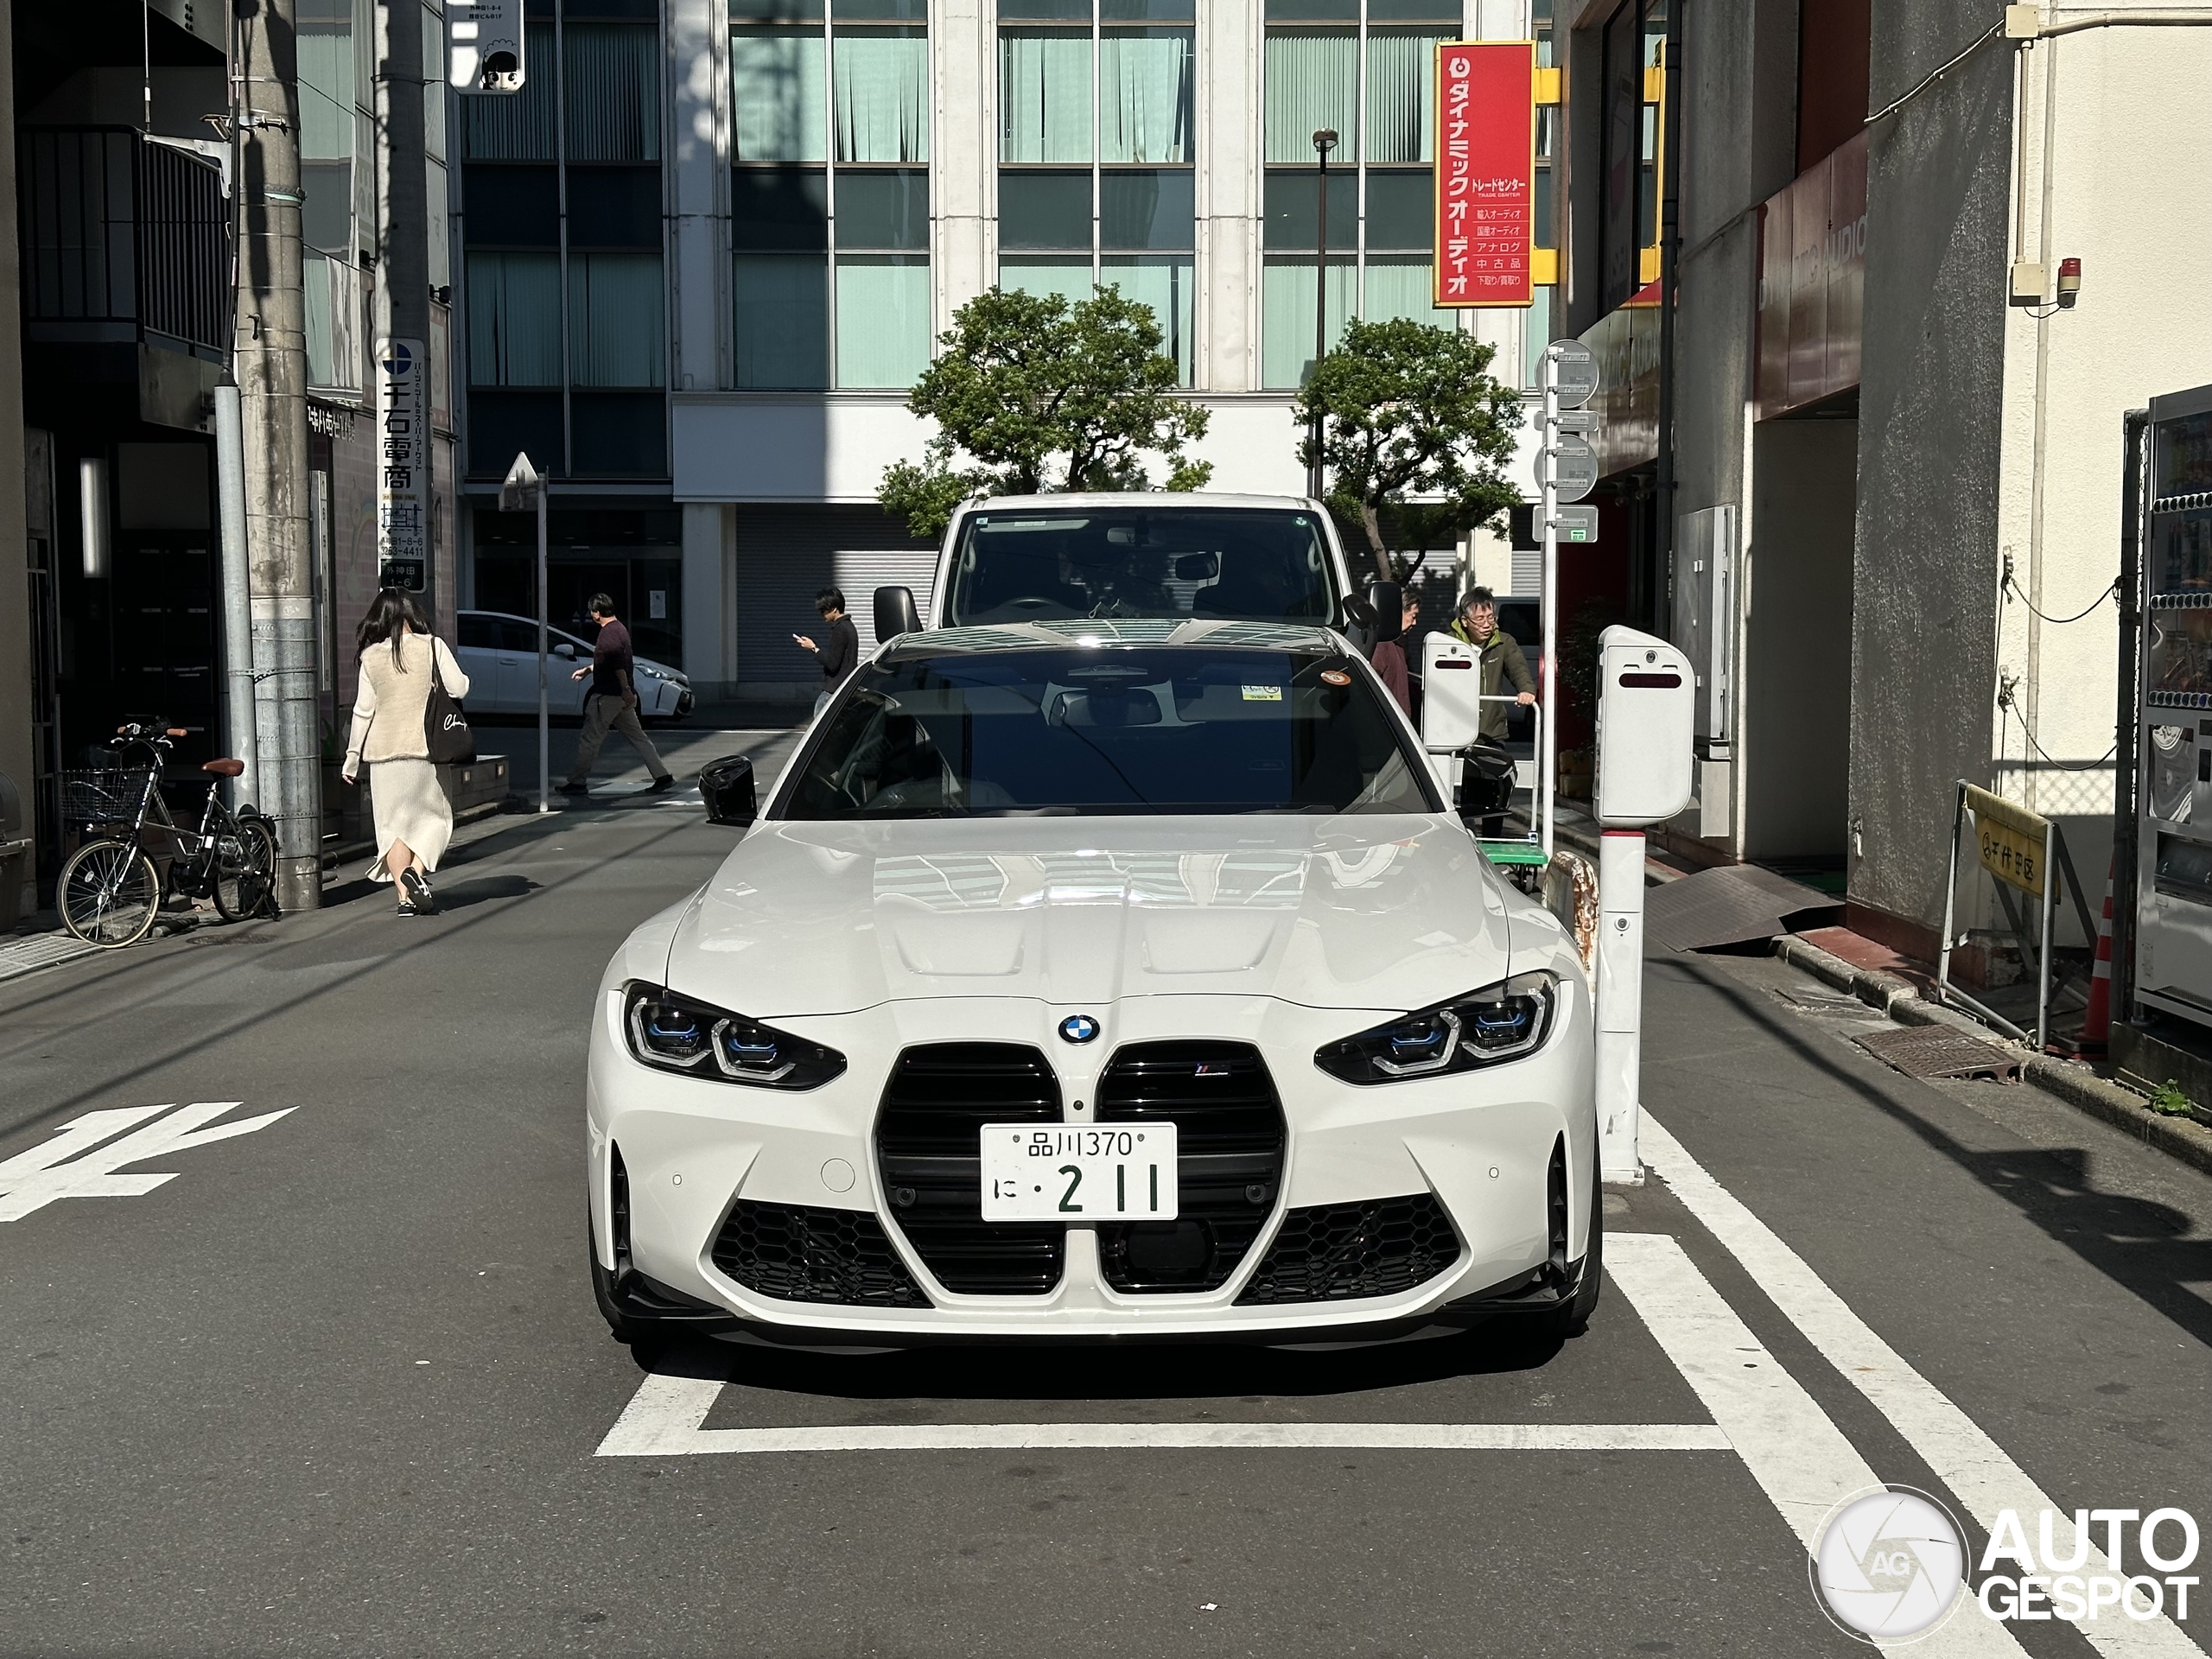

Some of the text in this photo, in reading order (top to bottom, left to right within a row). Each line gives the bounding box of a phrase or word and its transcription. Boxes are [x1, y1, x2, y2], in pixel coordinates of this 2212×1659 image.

[1471, 178, 1526, 194] トレードセンター
[1477, 208, 1522, 220] 輸入オーディオ
[1477, 225, 1521, 237] 国産オーディオ
[1477, 241, 1521, 253] アナログ
[1477, 257, 1521, 270] 中古品
[383, 382, 412, 489] 千石電商
[386, 566, 416, 575] 外神田
[391, 578, 411, 588] 1-6
[1991, 842, 2034, 881] 千代田区
